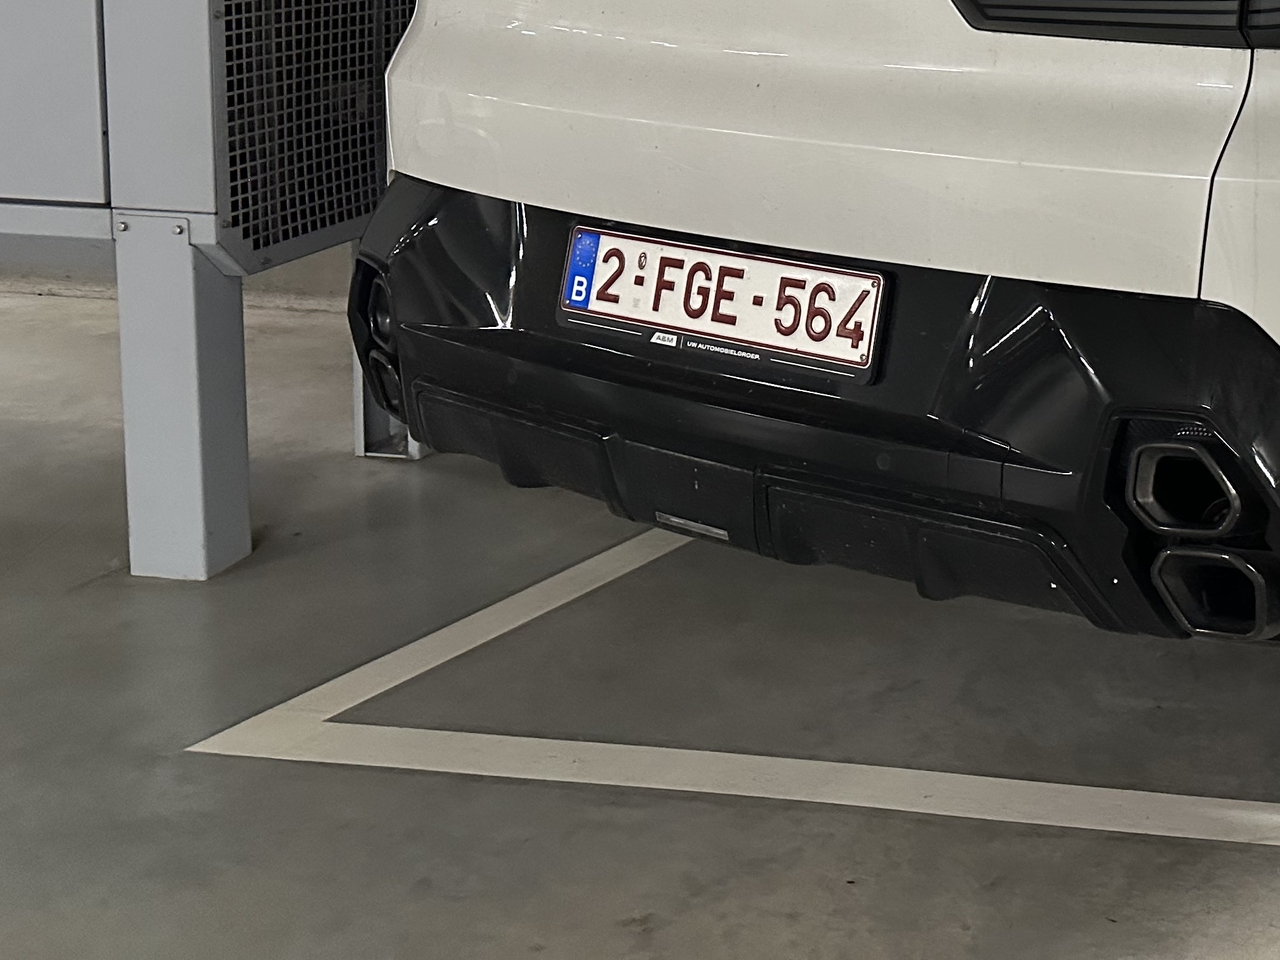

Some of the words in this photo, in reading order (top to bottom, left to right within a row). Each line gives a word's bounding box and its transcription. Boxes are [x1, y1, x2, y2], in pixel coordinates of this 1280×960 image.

[571, 275, 588, 302] B
[595, 247, 871, 349] 2-FGE-564
[686, 340, 698, 348] UW
